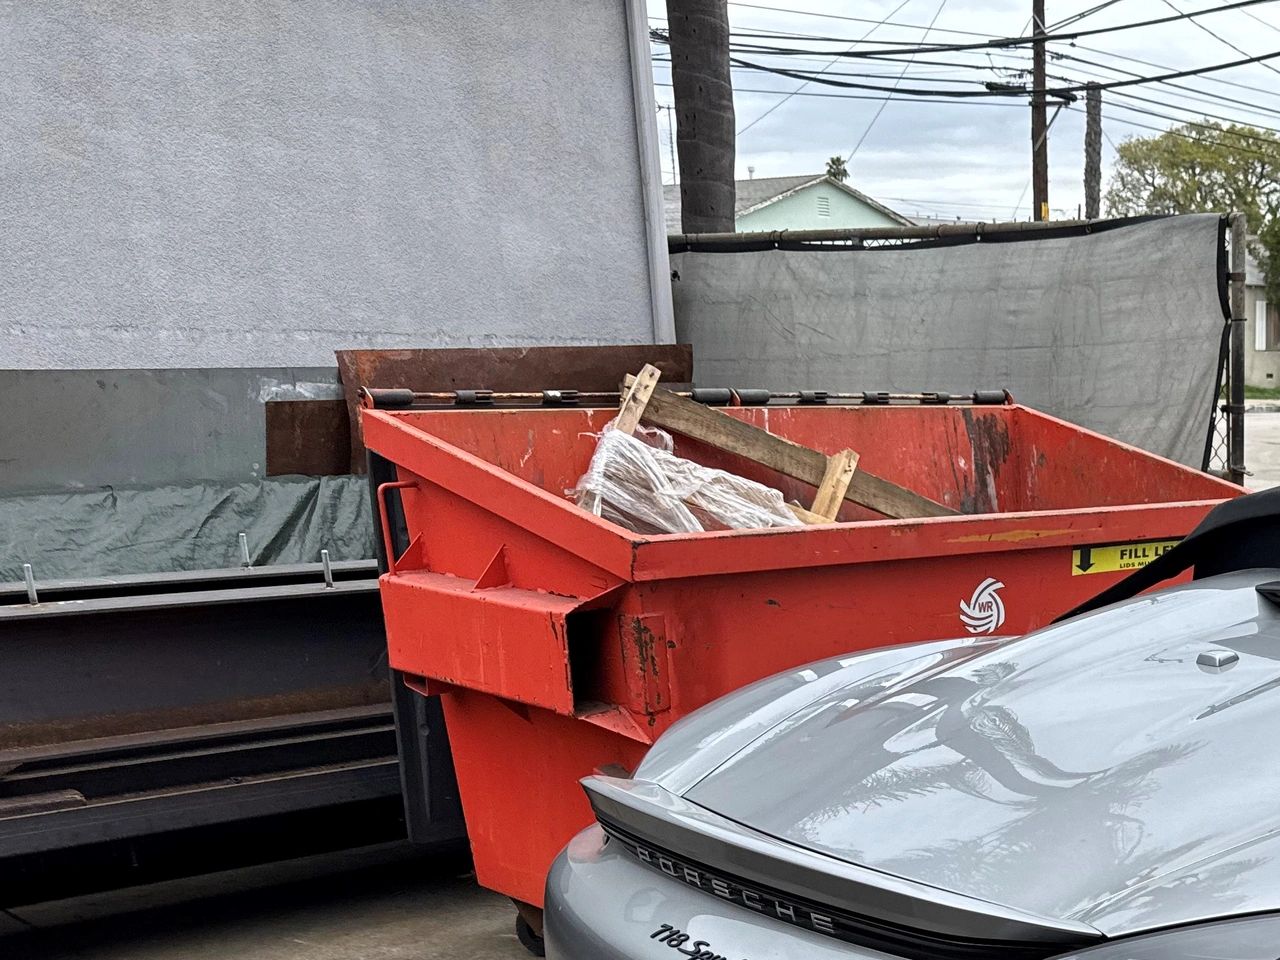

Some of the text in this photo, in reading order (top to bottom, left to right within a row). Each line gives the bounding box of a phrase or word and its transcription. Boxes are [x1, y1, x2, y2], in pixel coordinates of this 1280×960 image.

[1119, 548, 1149, 560] FILL
[978, 601, 993, 613] WR
[636, 845, 835, 934] PORSCHE
[649, 923, 690, 948] 718
